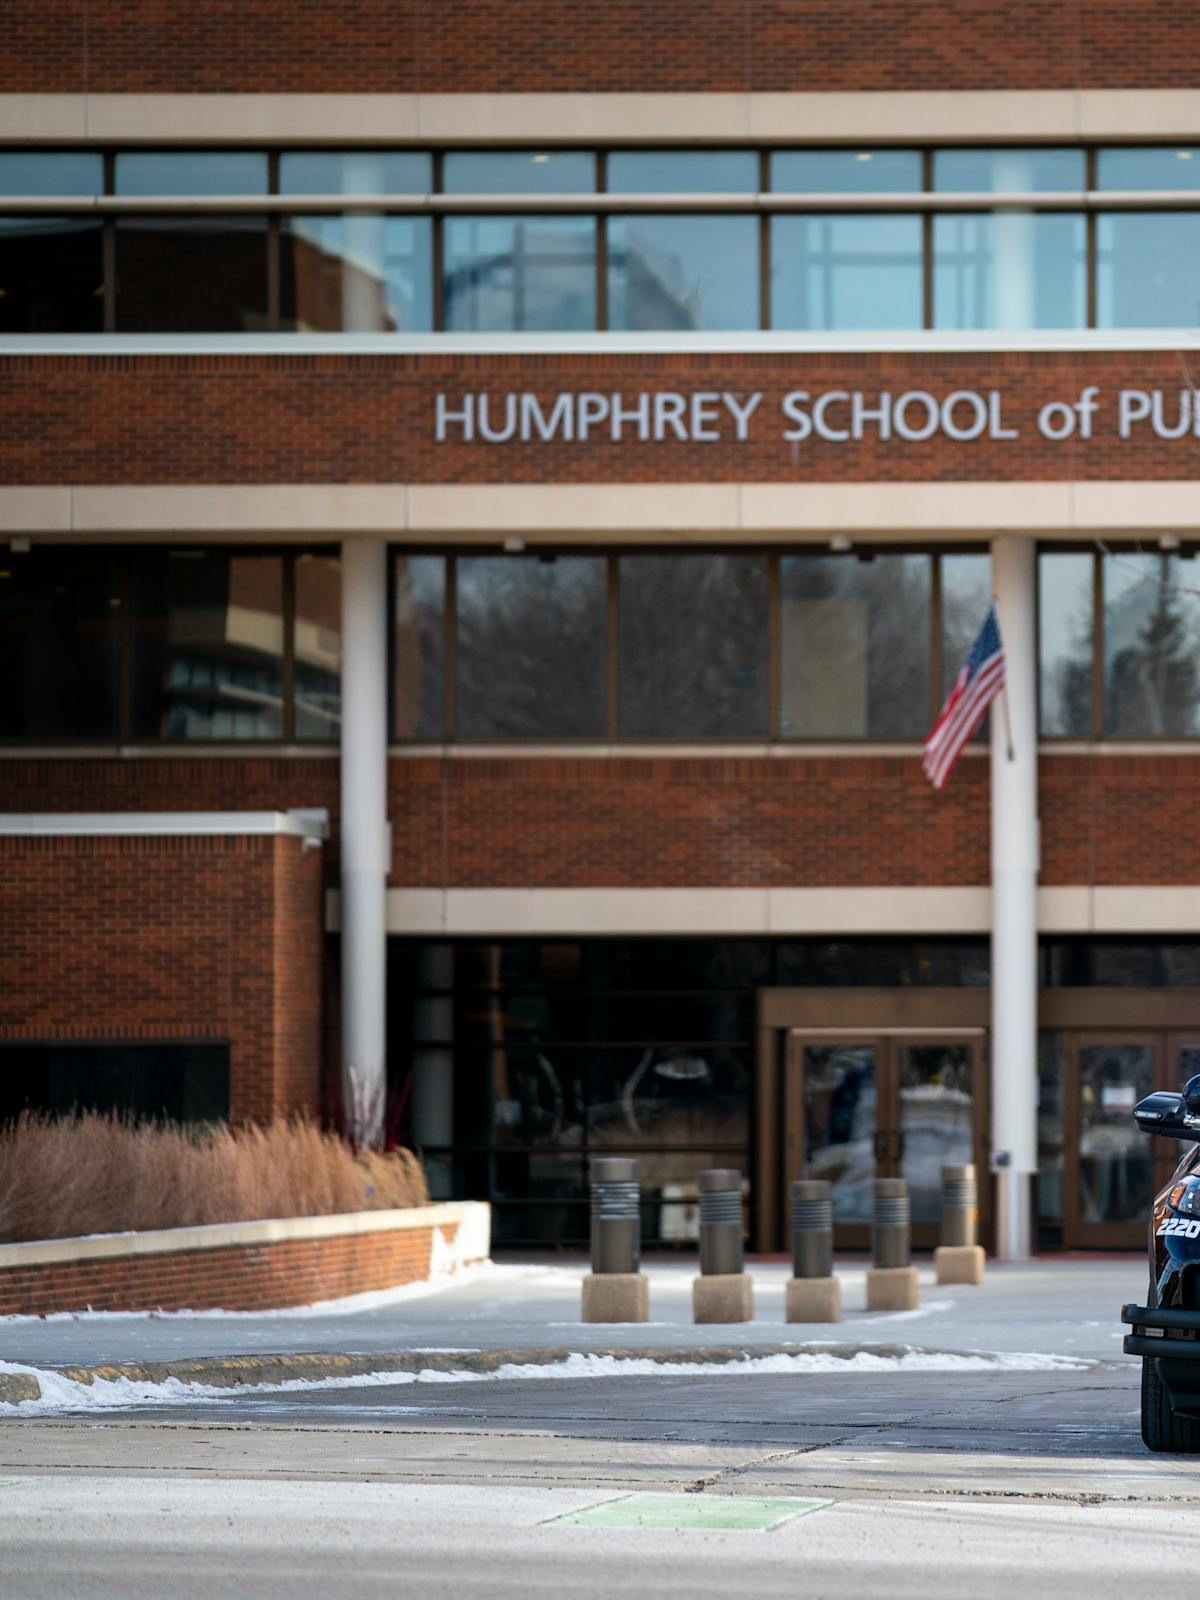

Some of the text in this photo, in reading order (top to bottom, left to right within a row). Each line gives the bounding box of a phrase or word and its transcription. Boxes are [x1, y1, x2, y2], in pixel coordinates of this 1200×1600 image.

[435, 393, 763, 442] HUMPHREY
[782, 390, 1019, 441] SCHOOL
[1038, 386, 1101, 439] of
